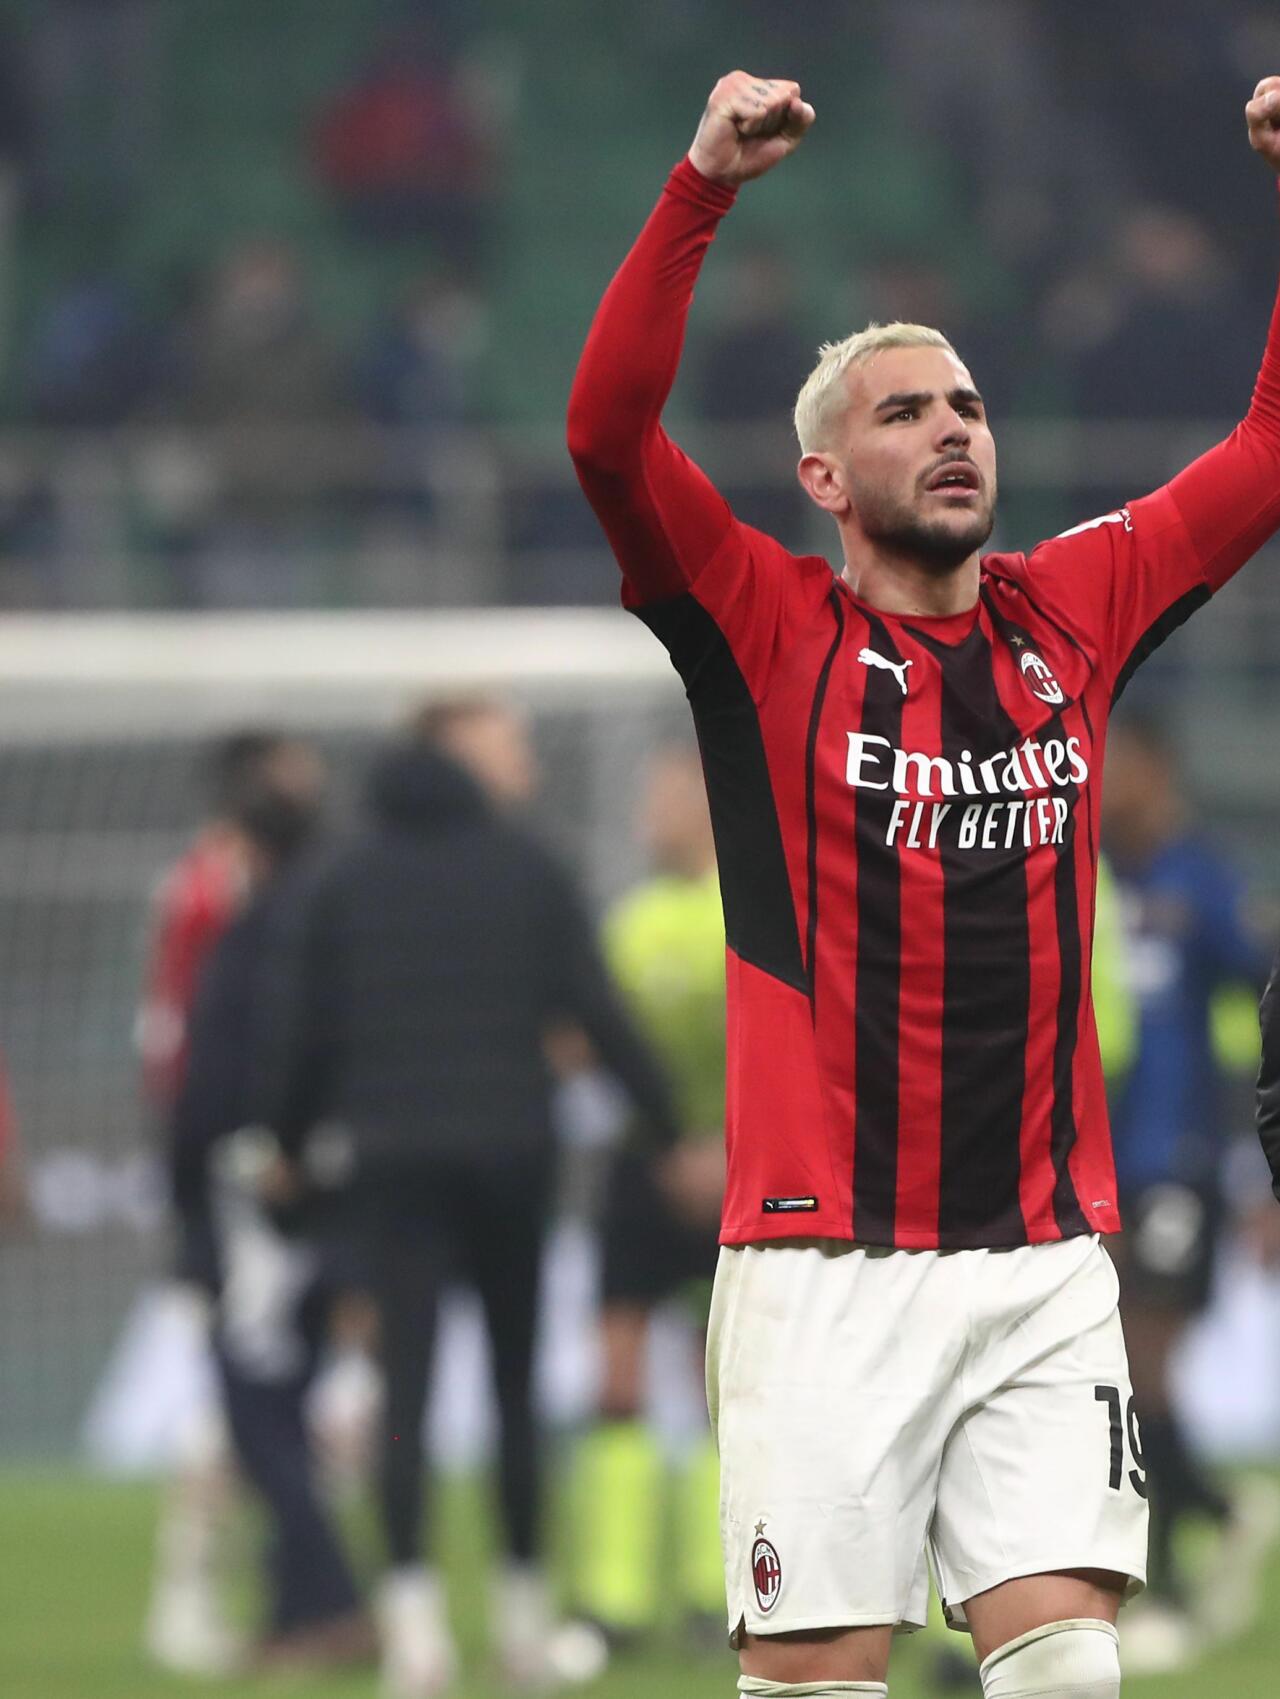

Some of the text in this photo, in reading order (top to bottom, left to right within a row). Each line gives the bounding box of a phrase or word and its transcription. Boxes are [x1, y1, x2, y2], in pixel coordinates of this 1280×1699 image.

[846, 731, 1088, 796] Emirates
[886, 798, 1068, 848] FLY BETTER
